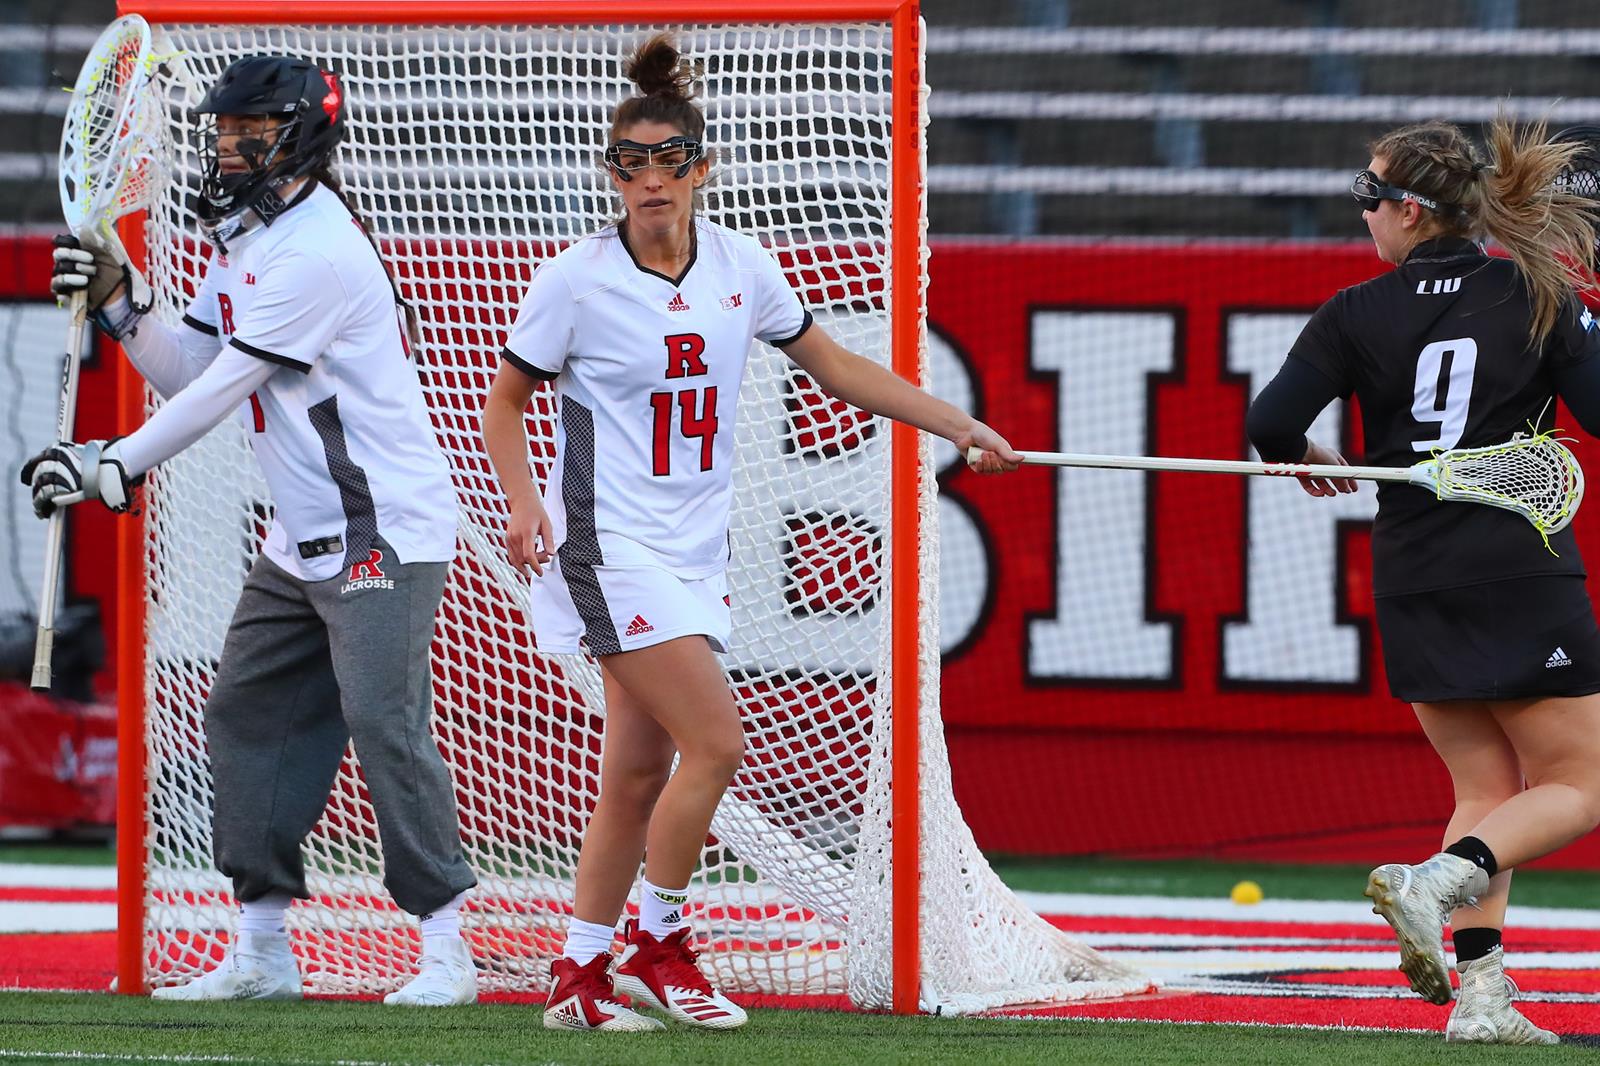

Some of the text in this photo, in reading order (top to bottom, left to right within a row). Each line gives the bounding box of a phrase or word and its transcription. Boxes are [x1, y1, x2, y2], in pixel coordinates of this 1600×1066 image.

[1416, 277, 1462, 295] LIU
[217, 292, 237, 336] R
[664, 332, 709, 380] R
[1411, 337, 1478, 453] 9
[649, 385, 719, 477] 14
[348, 548, 385, 583] R
[341, 579, 395, 594] LACROSSE
[625, 623, 655, 637] adidas
[1545, 658, 1572, 669] adidas
[553, 1012, 584, 1027] adidas
